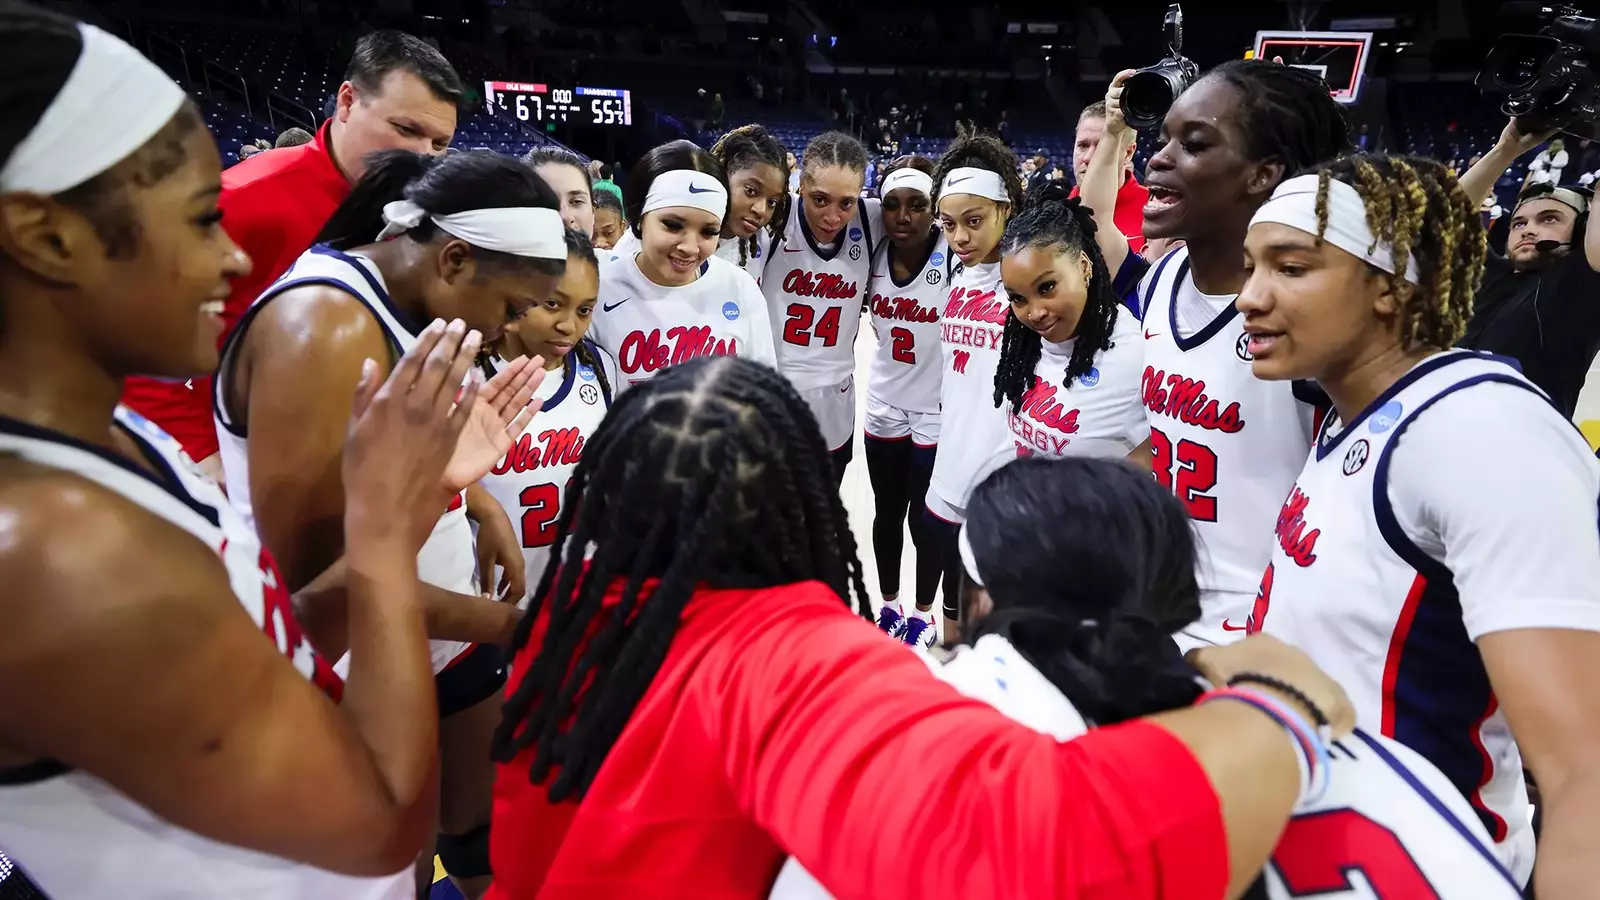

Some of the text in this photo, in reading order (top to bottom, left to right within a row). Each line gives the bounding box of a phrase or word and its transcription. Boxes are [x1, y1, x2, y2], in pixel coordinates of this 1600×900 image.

[516, 94, 542, 121] 67
[591, 99, 615, 124] 55
[782, 268, 858, 300] Ole Miss
[927, 270, 941, 284] SEC
[782, 302, 843, 348] 24
[870, 293, 941, 324] Ole Miss
[618, 327, 670, 375] Ole
[890, 326, 917, 366] 2
[1165, 373, 1246, 434] Miss
[538, 426, 585, 470] Mi
